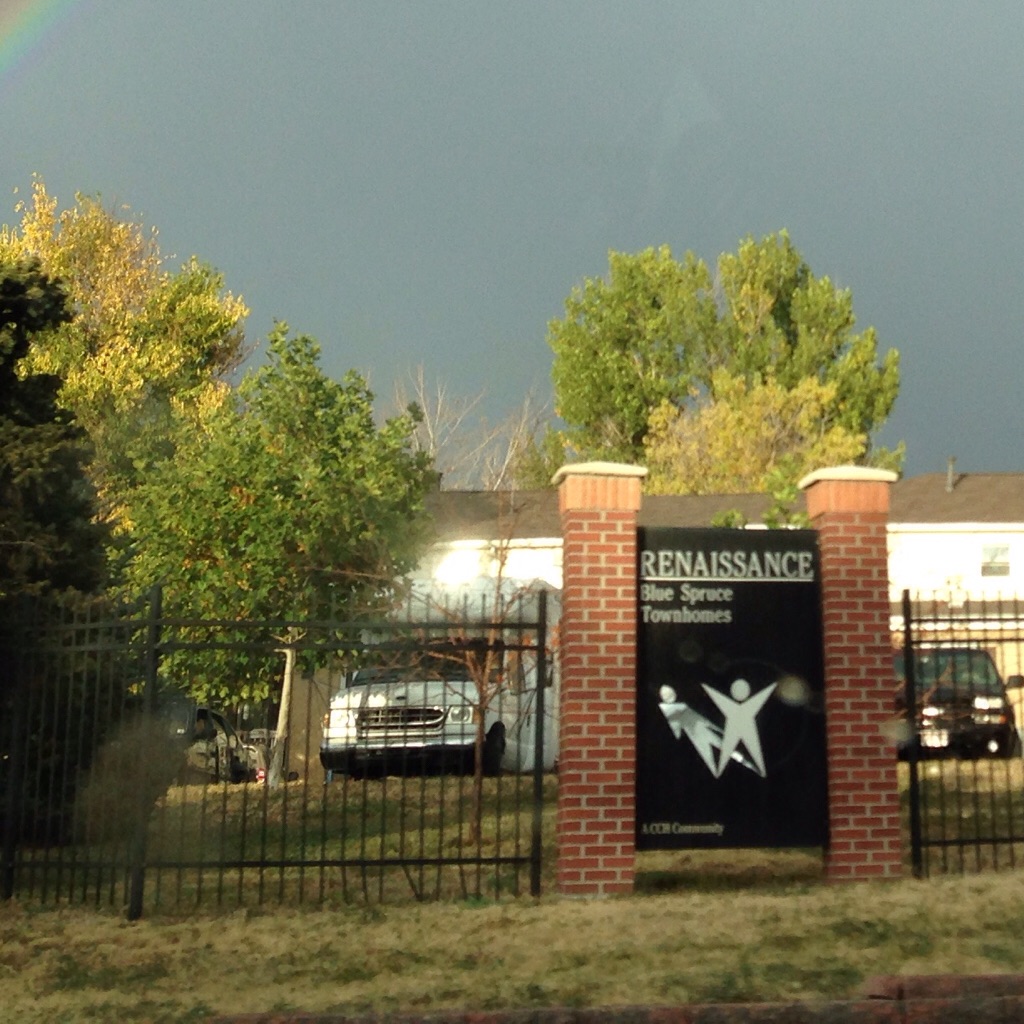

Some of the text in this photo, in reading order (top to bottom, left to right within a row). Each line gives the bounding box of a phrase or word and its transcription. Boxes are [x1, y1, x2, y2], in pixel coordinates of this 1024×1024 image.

[641, 550, 813, 577] RENAISSANCE
[641, 583, 733, 605] Blue Spruce
[641, 606, 732, 623] Townhomes
